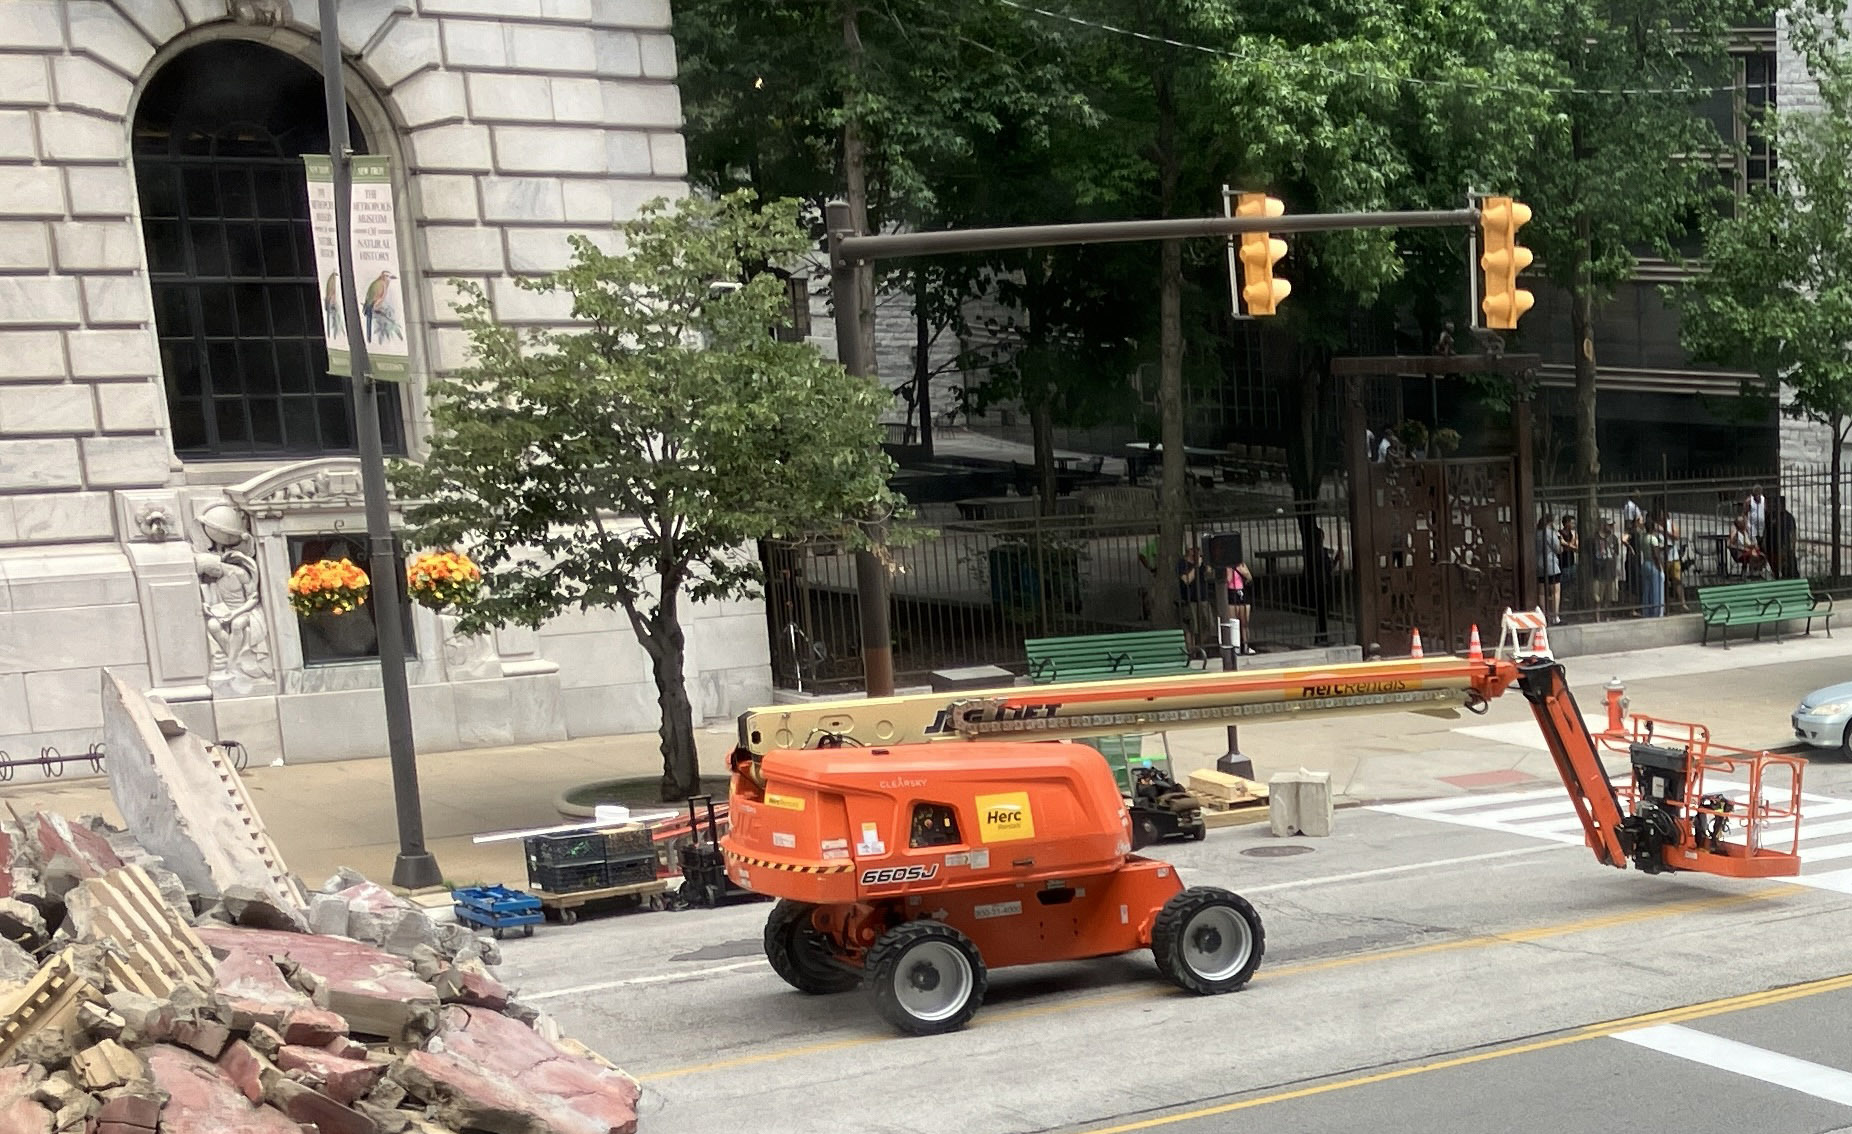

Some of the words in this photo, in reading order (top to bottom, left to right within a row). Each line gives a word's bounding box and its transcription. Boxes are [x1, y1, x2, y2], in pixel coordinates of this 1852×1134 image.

[365, 190, 377, 199] THE
[353, 202, 392, 211] METROPOLIS
[358, 214, 387, 223] MUSEUM
[358, 240, 390, 249] NATURAL
[360, 253, 390, 261] HISTORY
[987, 810, 1022, 824] Herc
